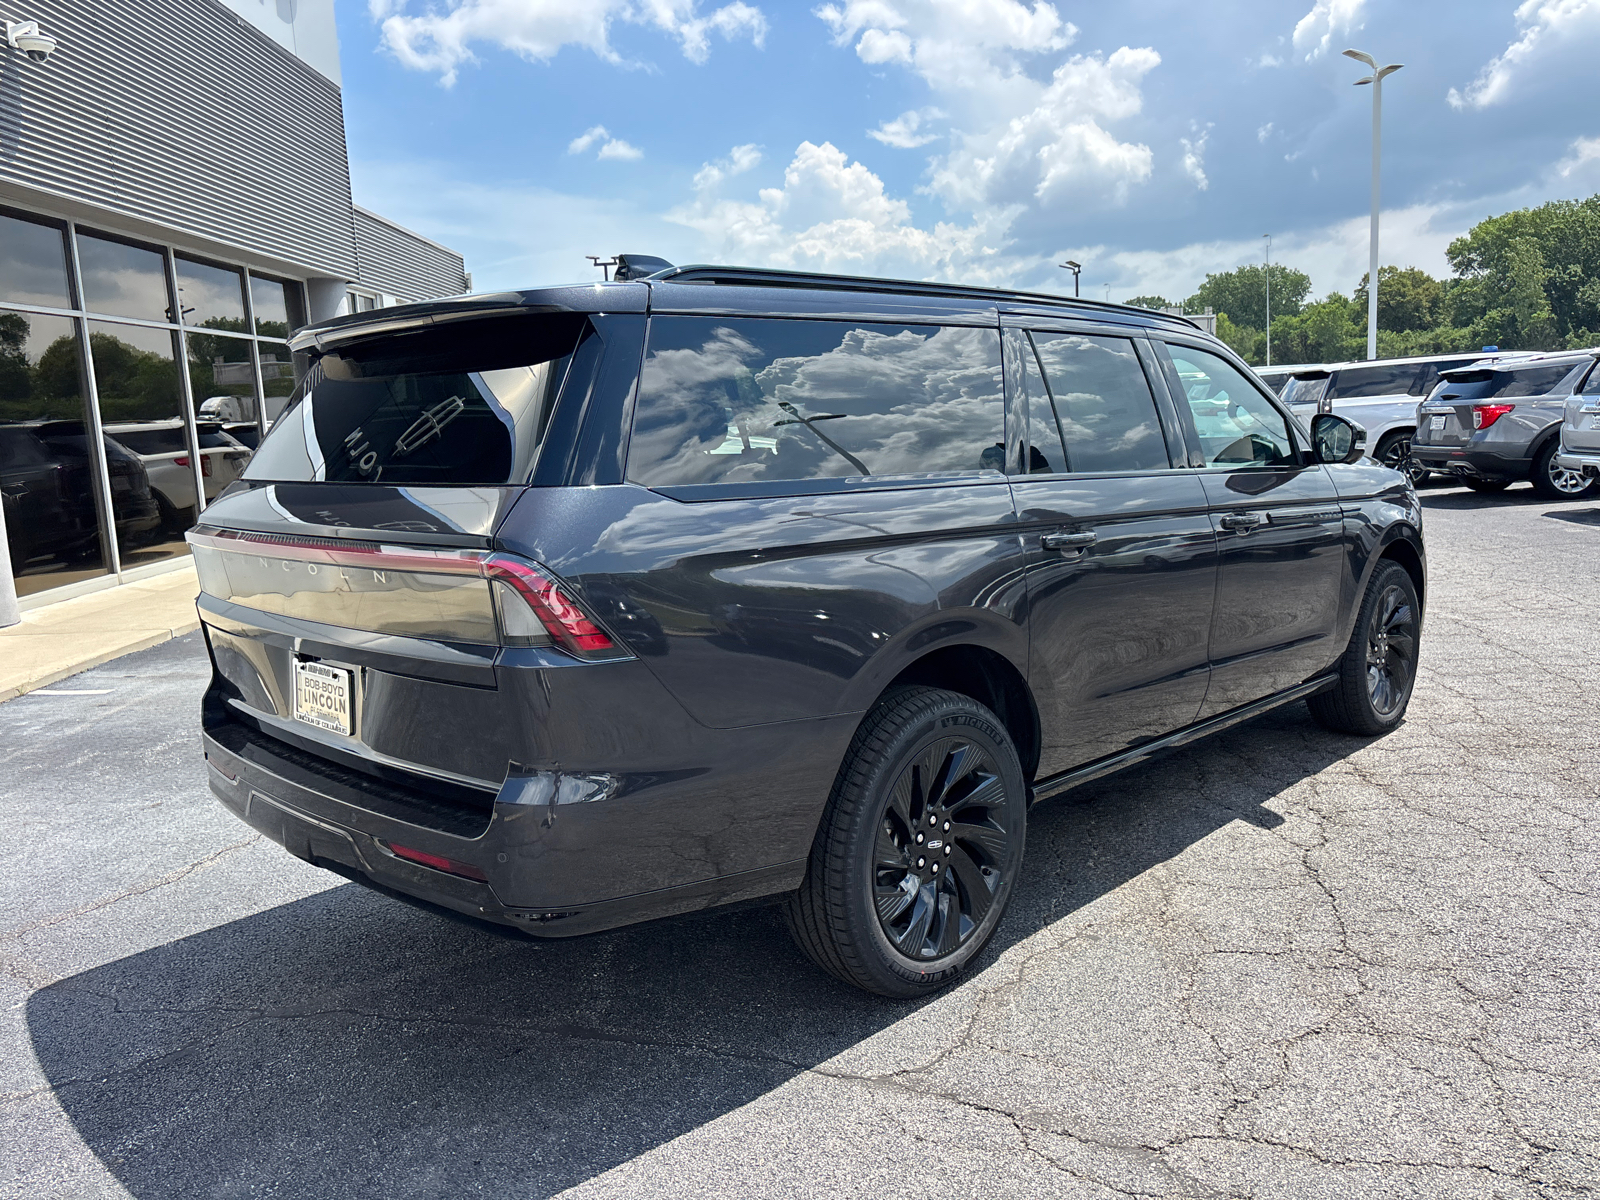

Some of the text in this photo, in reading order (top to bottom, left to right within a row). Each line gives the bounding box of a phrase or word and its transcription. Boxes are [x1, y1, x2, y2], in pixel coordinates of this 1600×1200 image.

[224, 556, 387, 584] INCOLN
[304, 677, 344, 697] BOB-BOYD
[303, 688, 346, 714] LINCOLN
[296, 713, 315, 724] LINCOLN
[315, 718, 321, 726] OF
[956, 716, 1003, 745] MICHELIN
